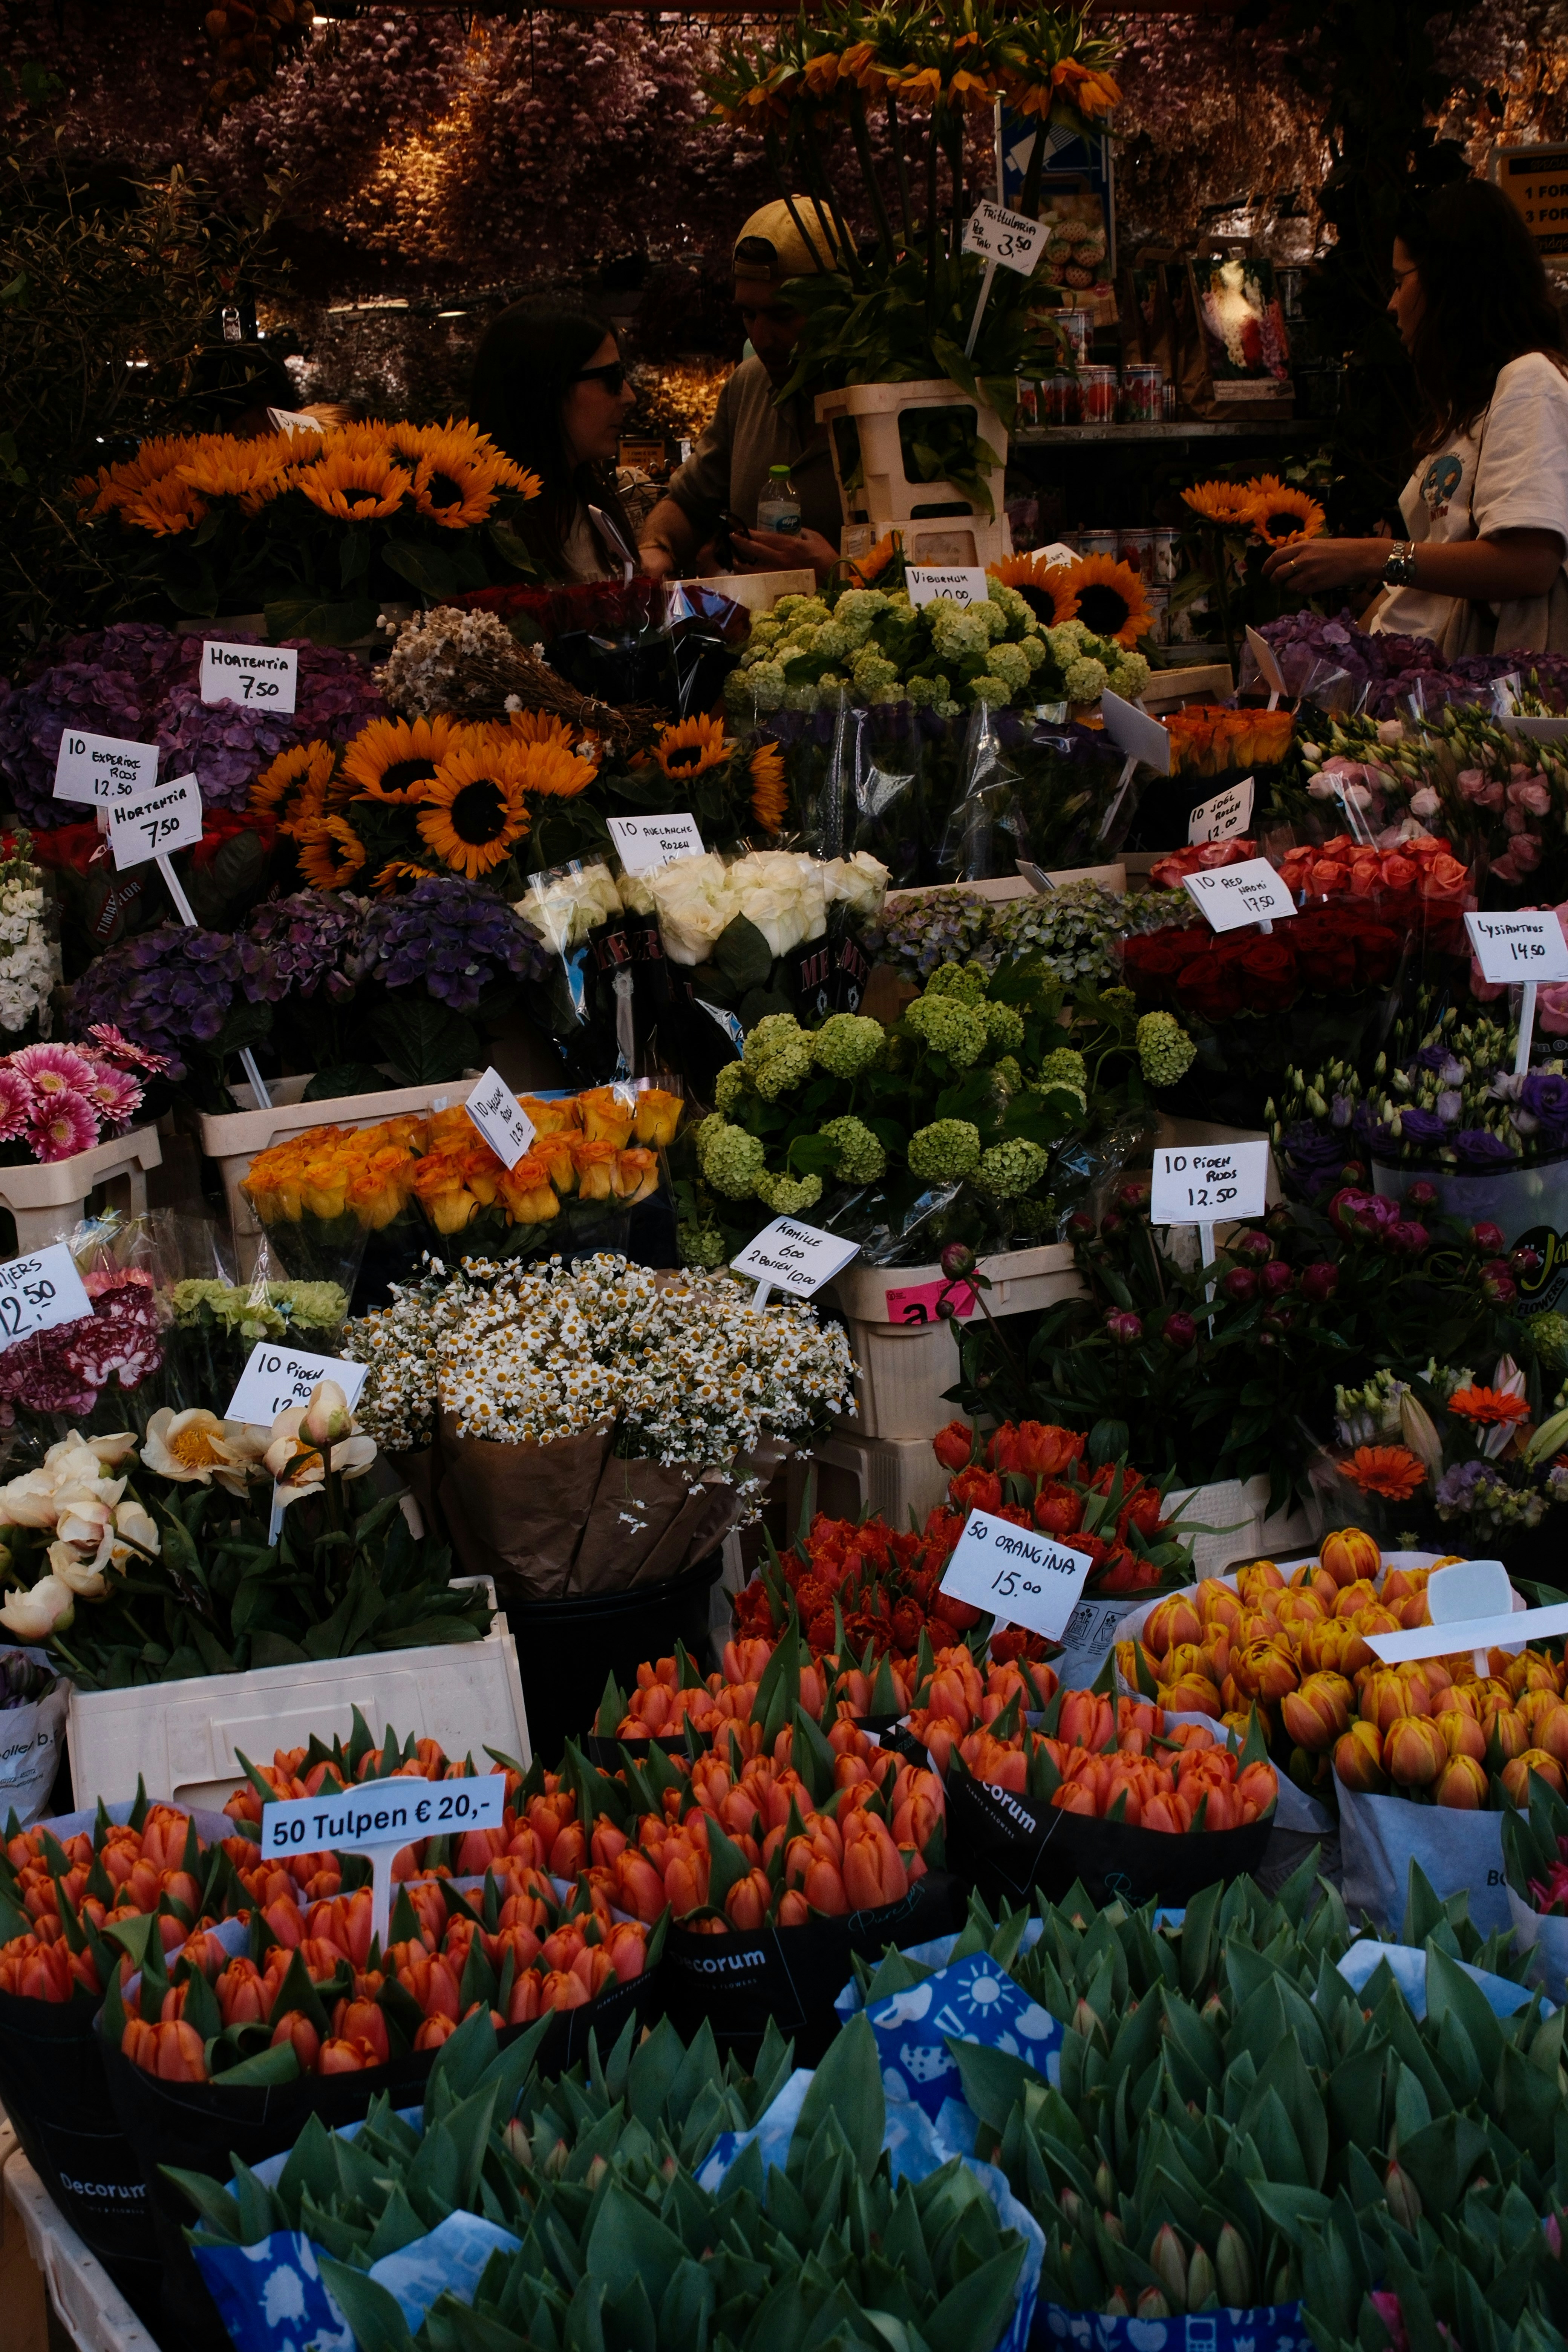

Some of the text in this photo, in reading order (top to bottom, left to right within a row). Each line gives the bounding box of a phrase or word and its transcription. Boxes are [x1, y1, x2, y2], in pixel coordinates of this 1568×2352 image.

[1530, 156, 1568, 170] SPECIA
[1525, 187, 1532, 199] 1
[1525, 210, 1534, 223] 3
[972, 218, 984, 236] PER
[239, 675, 279, 699] 7.50
[69, 738, 86, 755] 10
[110, 767, 137, 781] ROOS
[95, 778, 132, 796] 12.50
[1192, 808, 1204, 823] 10
[1215, 801, 1241, 821] ROZEN
[140, 817, 180, 848] 7.50
[618, 822, 637, 836] 10
[1208, 816, 1237, 842] 12.00
[1195, 876, 1243, 890] 10 RED
[1242, 895, 1275, 912] 17.50
[1510, 943, 1545, 960] 14.50
[1553, 1039, 1568, 1052] O
[474, 1101, 489, 1118] 10
[509, 1121, 524, 1147] 12.50
[1165, 1156, 1187, 1173] 10
[1188, 1187, 1237, 1206] 12.50
[778, 1244, 804, 1258] 6.00
[747, 1250, 816, 1285] 2 BOSSEN 10.00
[1521, 1233, 1568, 1291] Ja
[1517, 1276, 1566, 1315] FLOWERS
[258, 1353, 281, 1373] 10
[292, 1383, 312, 1397] RO
[272, 1397, 308, 1413] 12.
[967, 1521, 988, 1539] 50
[991, 1570, 1042, 1597] 15.00
[0, 1741, 34, 1759] olle
[982, 1780, 1037, 1835] corum
[273, 1794, 491, 1846] 50 Tulpen € 20,-
